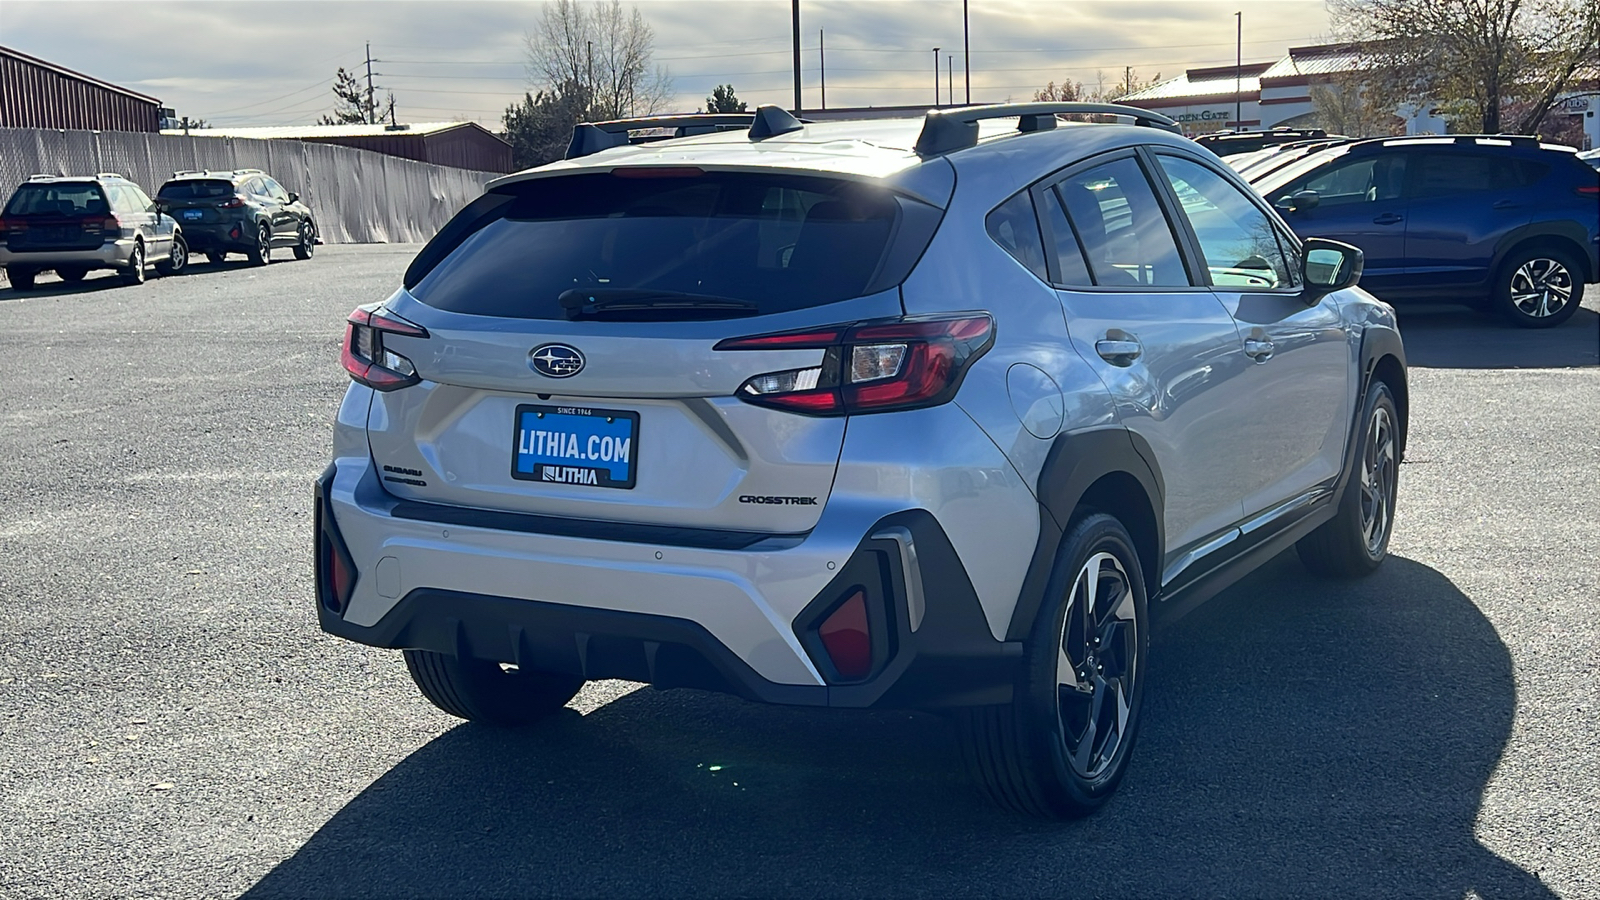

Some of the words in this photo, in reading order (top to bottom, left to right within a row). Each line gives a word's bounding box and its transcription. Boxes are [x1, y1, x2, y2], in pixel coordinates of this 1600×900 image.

[1201, 110, 1230, 121] GATE
[557, 407, 576, 415] SINCE
[577, 408, 592, 416] 1946
[518, 428, 631, 464] LITHIA.COM
[383, 464, 423, 477] SUBARU
[554, 466, 598, 485] LITHIA
[738, 495, 818, 505] CROSSTREK
